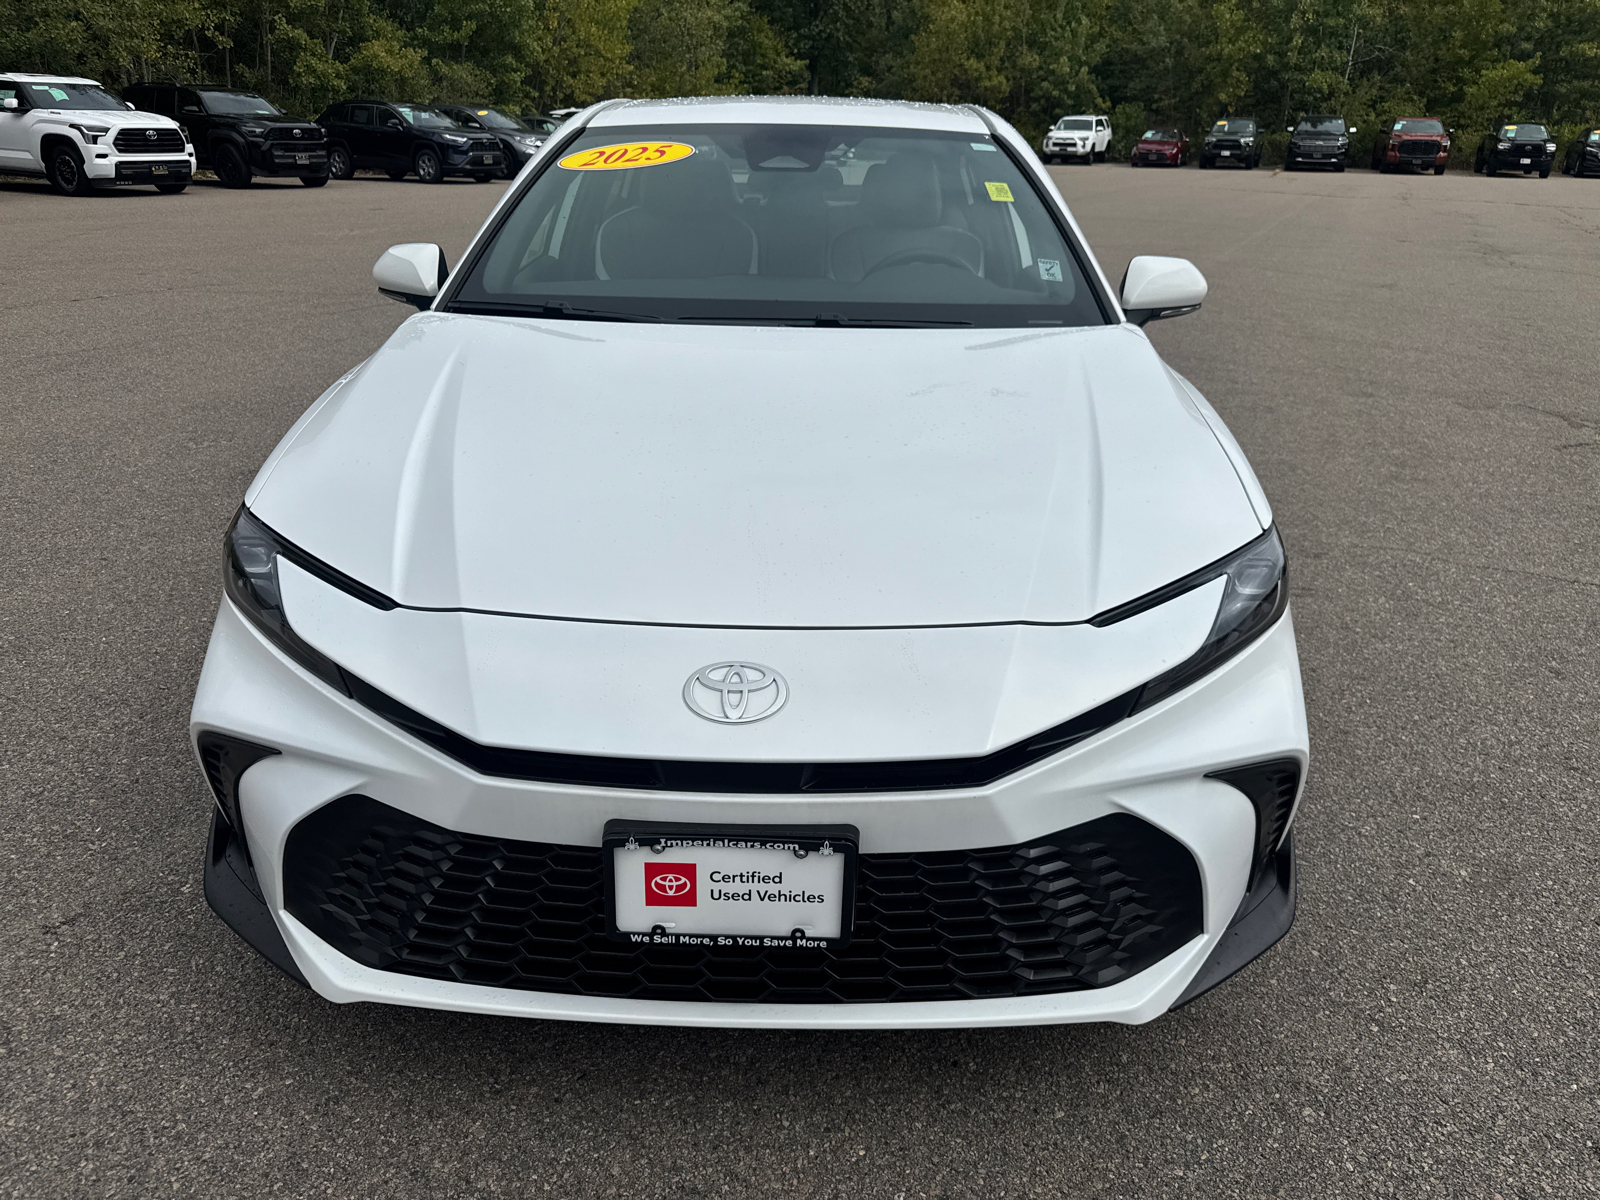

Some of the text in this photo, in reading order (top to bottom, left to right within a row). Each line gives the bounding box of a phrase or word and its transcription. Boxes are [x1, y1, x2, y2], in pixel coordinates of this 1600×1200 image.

[578, 144, 674, 167] 2025
[659, 838, 799, 851] Imperialcars.com
[709, 870, 783, 885] Certified
[710, 888, 825, 904] Used Vehicles
[630, 934, 827, 948] We Sell More, So You Save More
